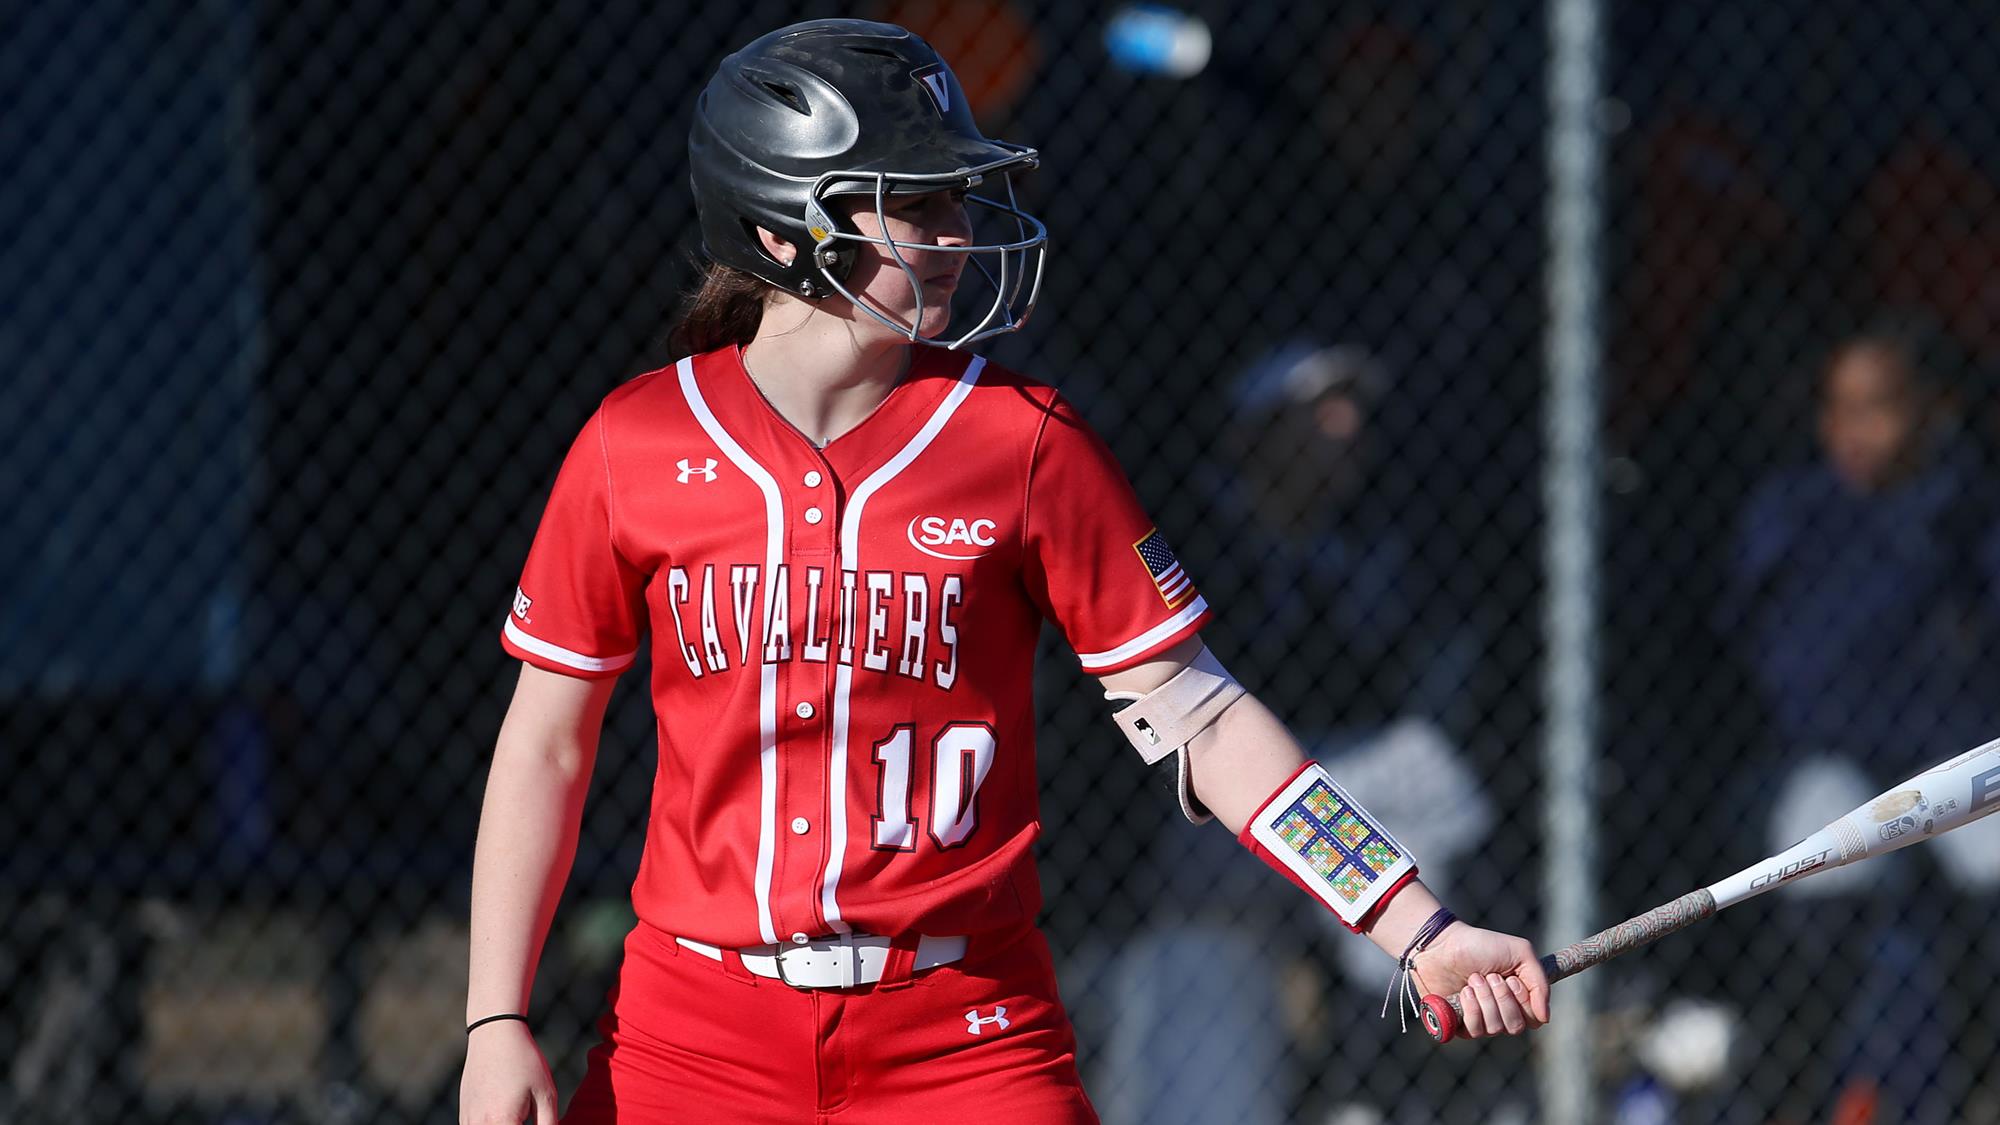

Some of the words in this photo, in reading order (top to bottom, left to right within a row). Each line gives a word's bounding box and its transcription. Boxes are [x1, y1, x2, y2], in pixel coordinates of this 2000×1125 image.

[922, 71, 950, 113] V
[919, 516, 997, 548] SAC
[667, 563, 963, 690] CAVALIERS
[870, 720, 999, 853] 10
